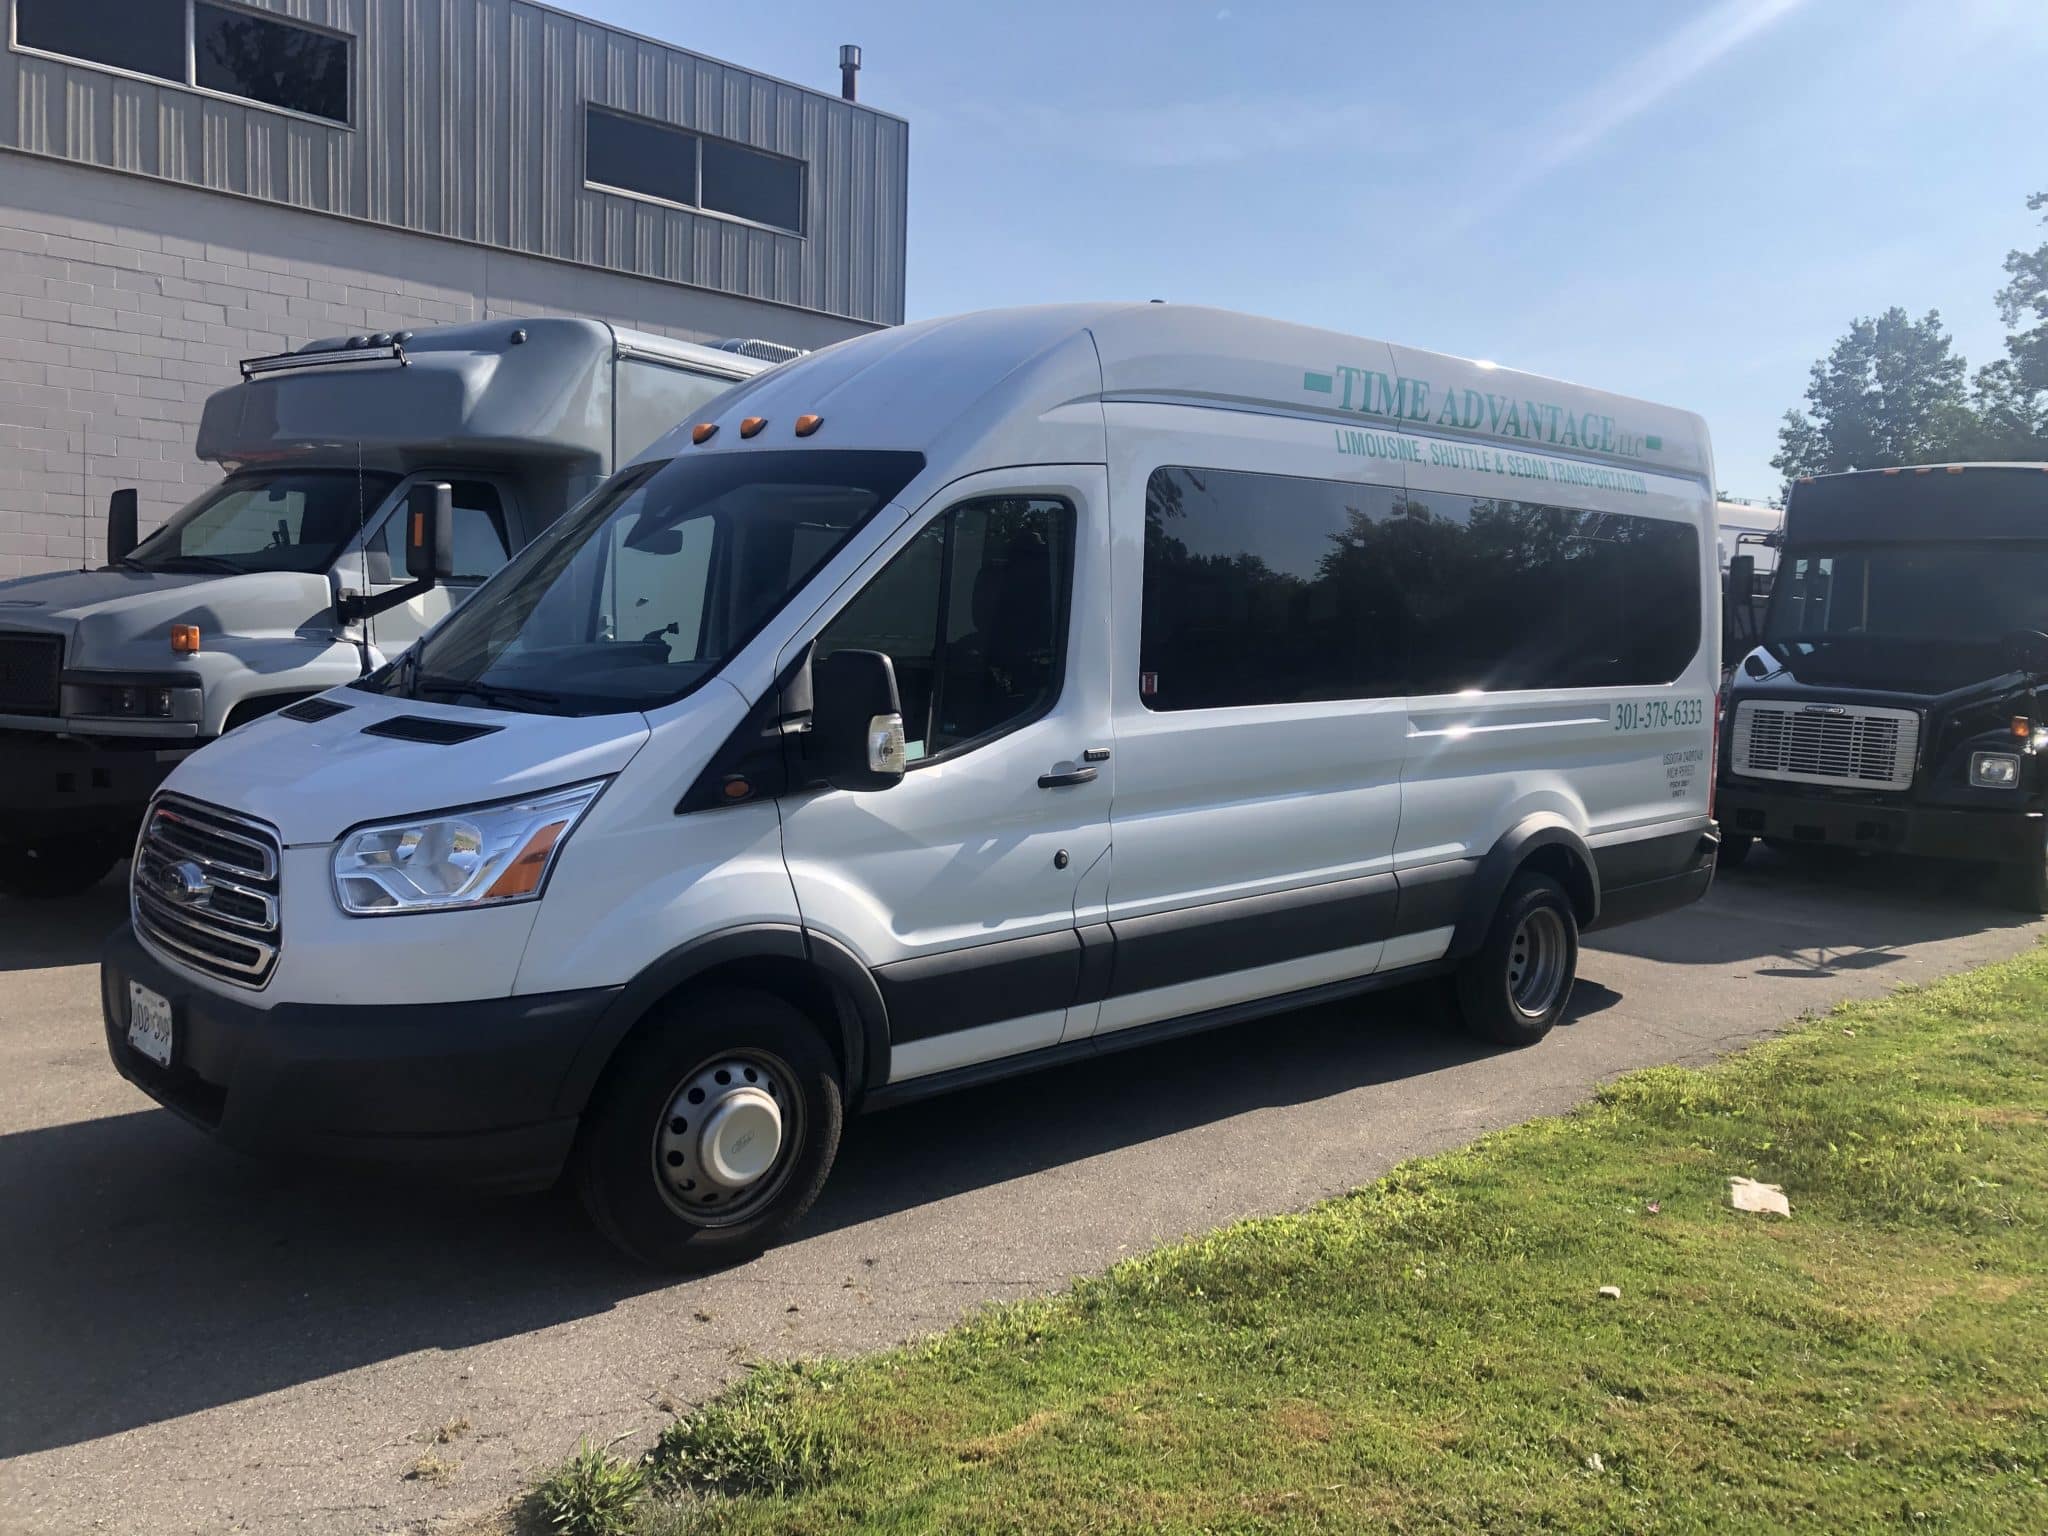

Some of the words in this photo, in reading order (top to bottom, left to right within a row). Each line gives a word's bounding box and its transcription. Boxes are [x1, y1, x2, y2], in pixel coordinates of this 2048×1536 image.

[1336, 365, 1430, 422] TIME
[1437, 385, 1616, 452] ADVANTAGE
[1617, 430, 1644, 458] LLC
[1335, 428, 1427, 466] LIMOUSINE,
[1430, 442, 1491, 473] SHUTTLE
[1496, 453, 1505, 475] &
[1508, 455, 1549, 481] SEDAN
[1551, 461, 1647, 494] TRANSPORTATION
[1615, 698, 1703, 730] 301-378-6333
